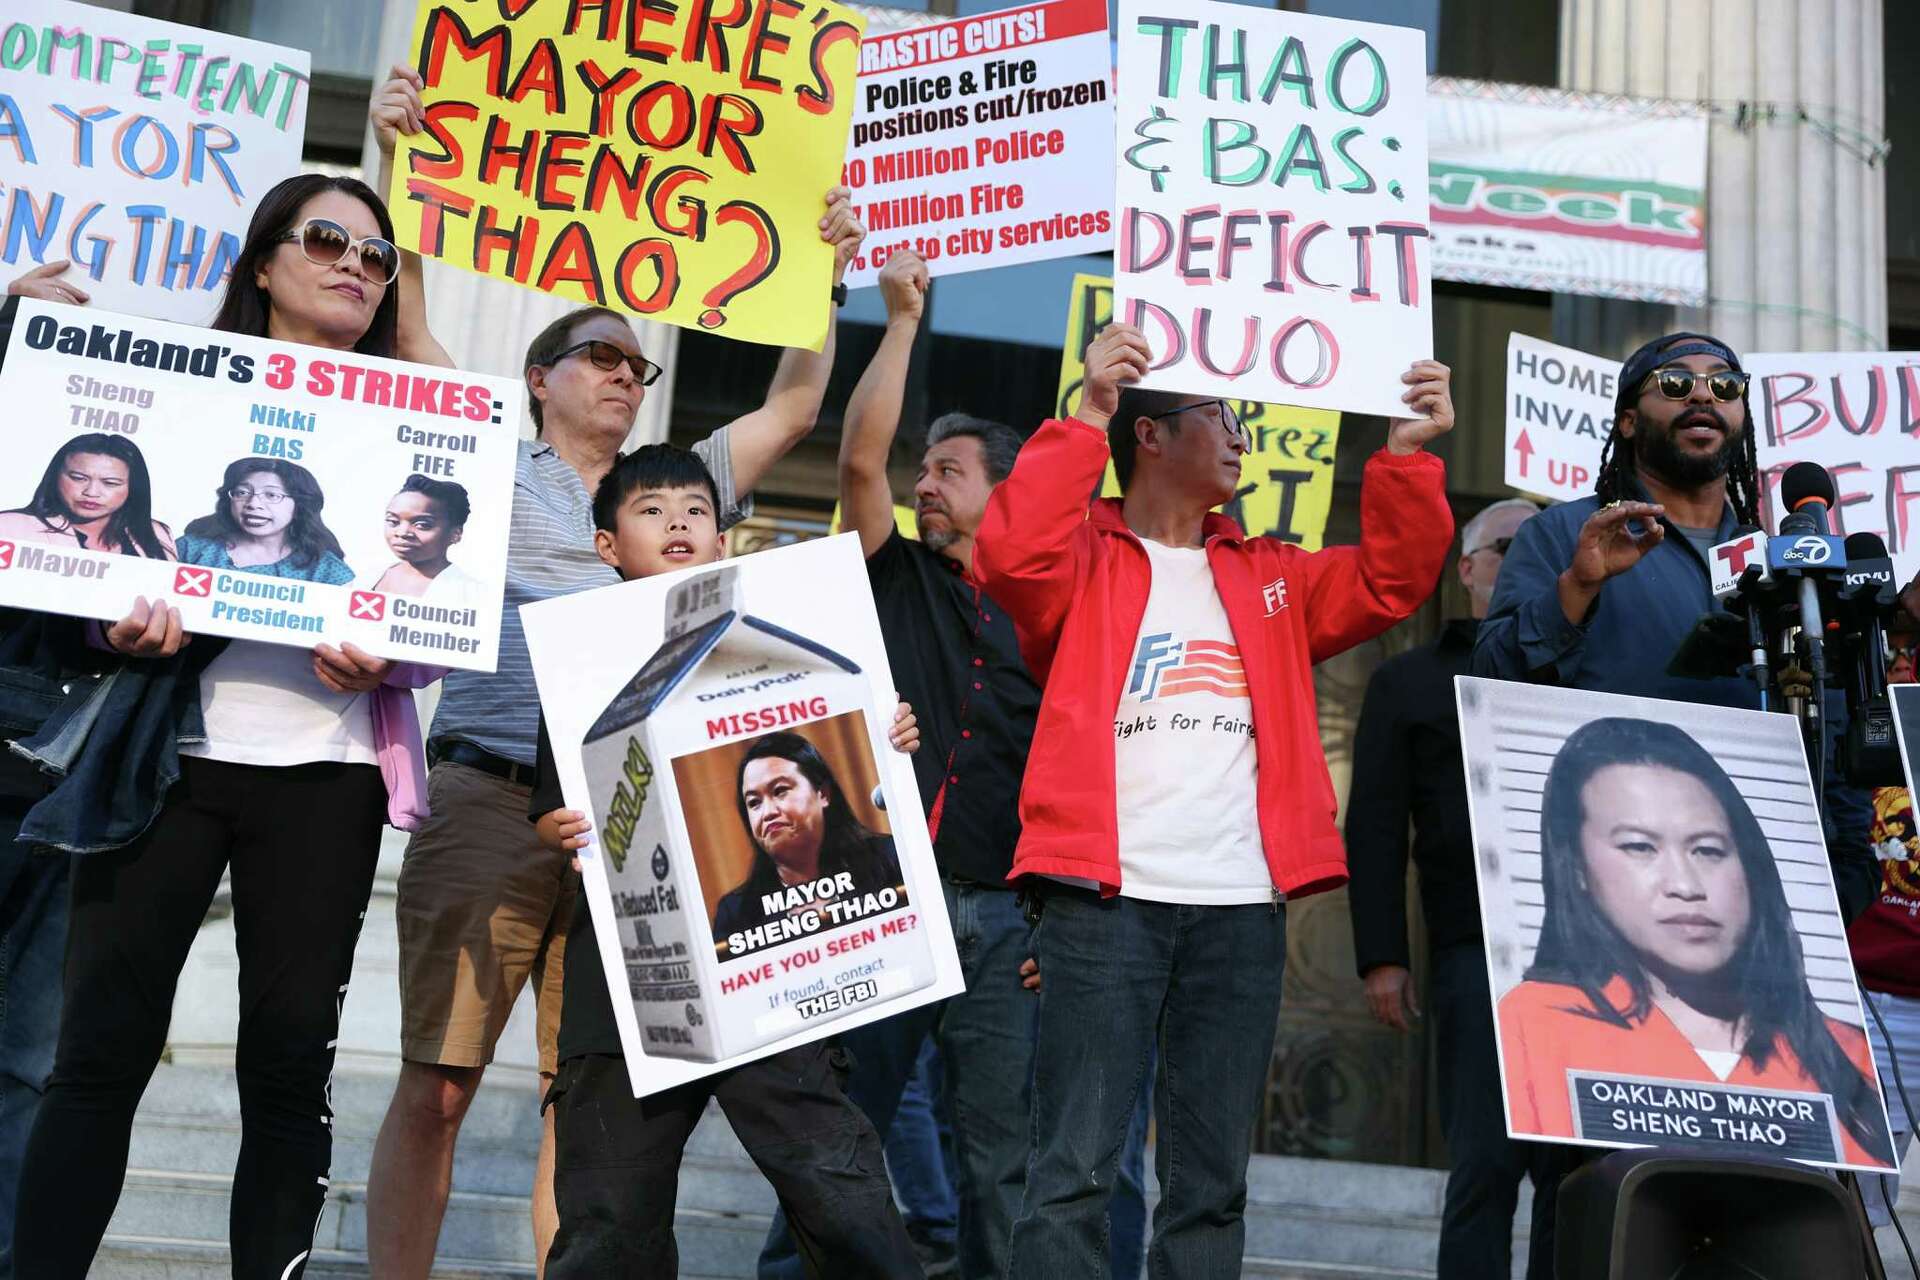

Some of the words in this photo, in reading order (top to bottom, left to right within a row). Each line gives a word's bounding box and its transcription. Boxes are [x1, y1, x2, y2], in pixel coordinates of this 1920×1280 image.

[858, 24, 960, 73] RASTIC
[964, 9, 1045, 53] CUTS!
[1, 22, 310, 132] OMPETENT
[866, 75, 952, 112] Police
[958, 70, 978, 96] &
[984, 58, 1037, 91] Fire
[1137, 15, 1390, 117] THAO
[419, 6, 765, 175] MAYOR
[853, 104, 968, 147] positions
[974, 79, 1106, 124] cut/frozen
[408, 101, 712, 241] SHENG
[873, 146, 968, 184] Million
[975, 129, 1064, 167] Police
[1125, 105, 1181, 192] &
[1202, 117, 1405, 202] BAS:
[868, 192, 964, 232] Million
[970, 184, 1024, 215] Fire
[0, 182, 115, 282] NG
[406, 178, 781, 328] THAO?
[947, 229, 992, 256] city
[999, 210, 1111, 248] services
[1120, 204, 1430, 307] DEFICIT
[1125, 297, 1340, 390] DUO
[26, 314, 254, 384] Oakland's
[265, 353, 295, 391] 3
[307, 360, 504, 425] STRIKES:
[66, 374, 154, 410] Sheng
[1516, 350, 1614, 399] HOME
[69, 405, 139, 435] THAO
[249, 403, 316, 433] Nikki
[396, 425, 477, 454] Carroll
[1515, 394, 1615, 442] INVAS
[252, 434, 304, 461] BAS
[412, 453, 455, 478] FIFE
[1548, 459, 1588, 489] UP
[17, 546, 110, 582] Mayor
[1783, 548, 1805, 561] abc
[1794, 535, 1831, 564] 7
[217, 574, 305, 604] Council
[1263, 581, 1287, 613] FF
[212, 601, 324, 634] President
[392, 599, 477, 628] Council
[389, 625, 481, 655] Member
[706, 696, 828, 739] MISSING
[1170, 713, 1201, 730] for
[603, 735, 653, 873] MILK!
[657, 884, 679, 913] Fat
[761, 872, 855, 916] MAYOR
[728, 911, 820, 955] SHENG
[826, 887, 898, 924] THAO
[720, 964, 775, 995] HAVE
[780, 948, 820, 974] YOU
[827, 929, 876, 957] SEEN
[880, 914, 917, 938] ME?
[769, 993, 782, 1009] If
[783, 977, 830, 1003] found,
[834, 958, 885, 986] contact
[796, 992, 841, 1019] THE
[843, 979, 878, 1005] FBI
[1592, 1082, 1716, 1112] OAKLAND
[1727, 1094, 1815, 1121] MAYOR
[1612, 1109, 1701, 1137] SHENG
[1711, 1118, 1786, 1145] THAO
